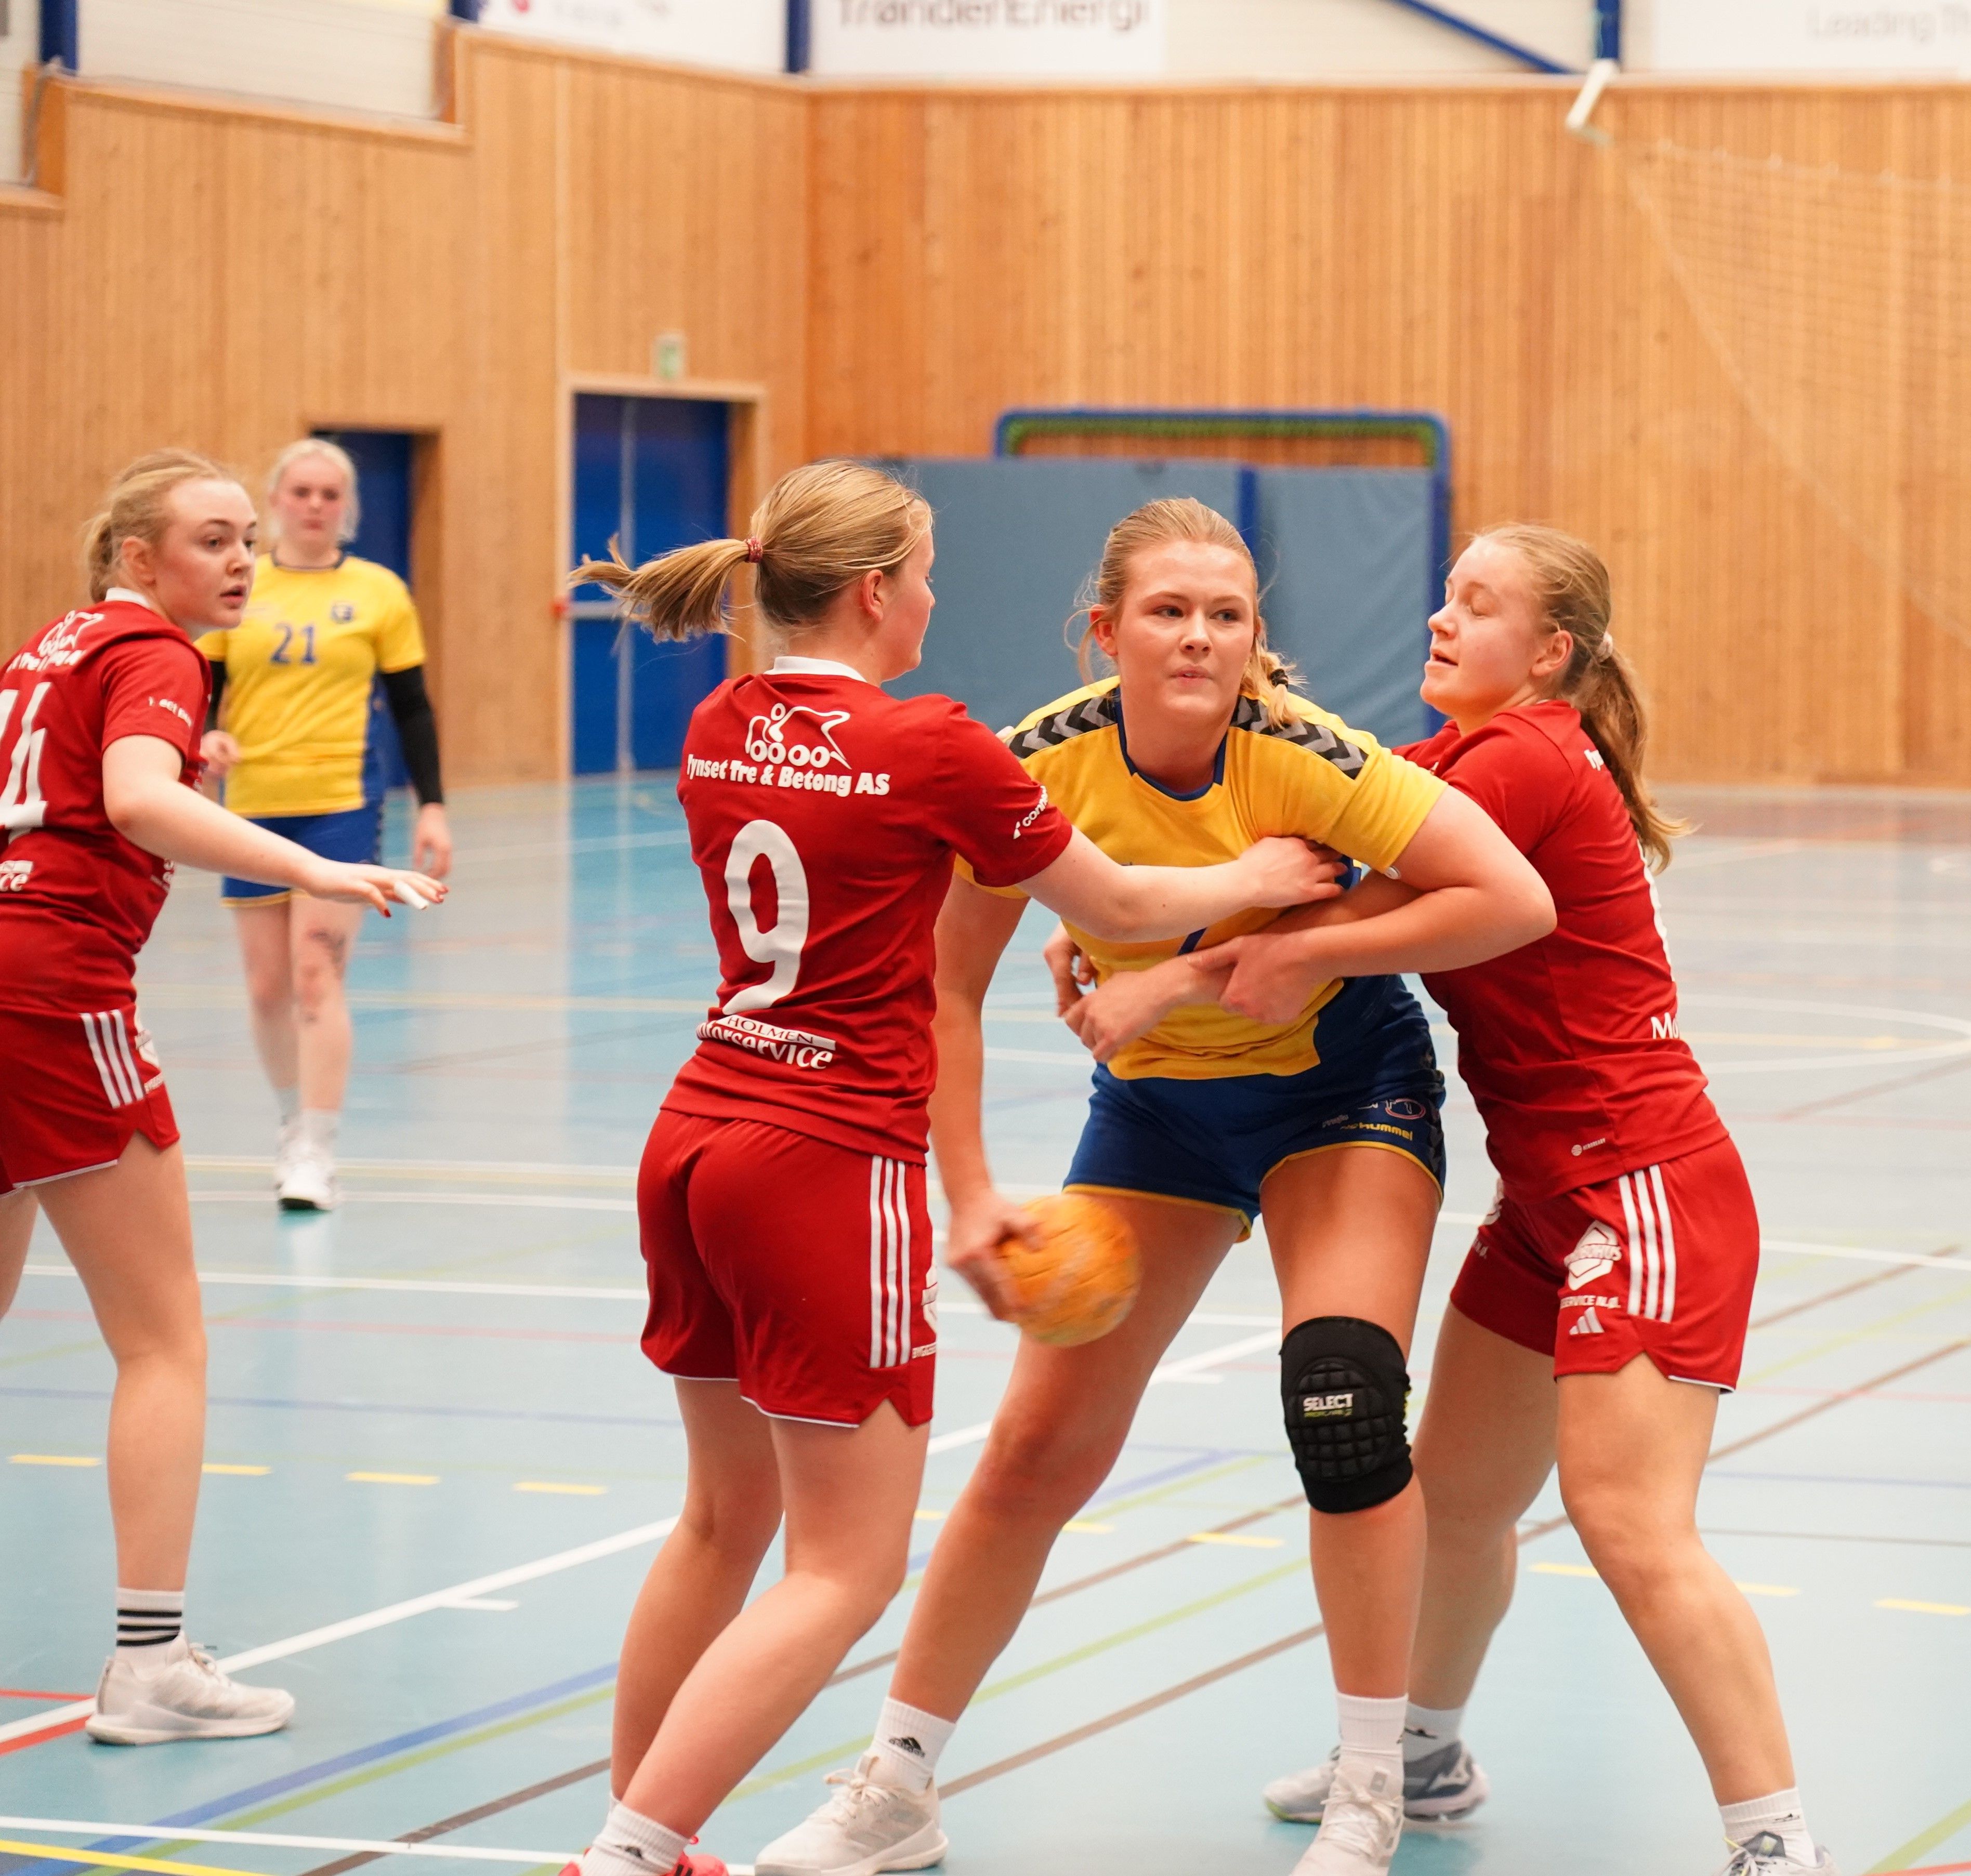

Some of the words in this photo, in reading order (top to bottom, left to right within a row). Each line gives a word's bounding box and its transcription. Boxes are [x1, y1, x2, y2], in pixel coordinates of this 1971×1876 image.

[270, 623, 316, 665] 21
[730, 760, 757, 784] Tre
[760, 764, 774, 786] &
[778, 766, 852, 797] Betong
[855, 772, 890, 796] AS
[722, 820, 809, 1015] 9
[728, 1016, 813, 1044] HOLMEN
[1303, 1393, 1354, 1412] SELECT
